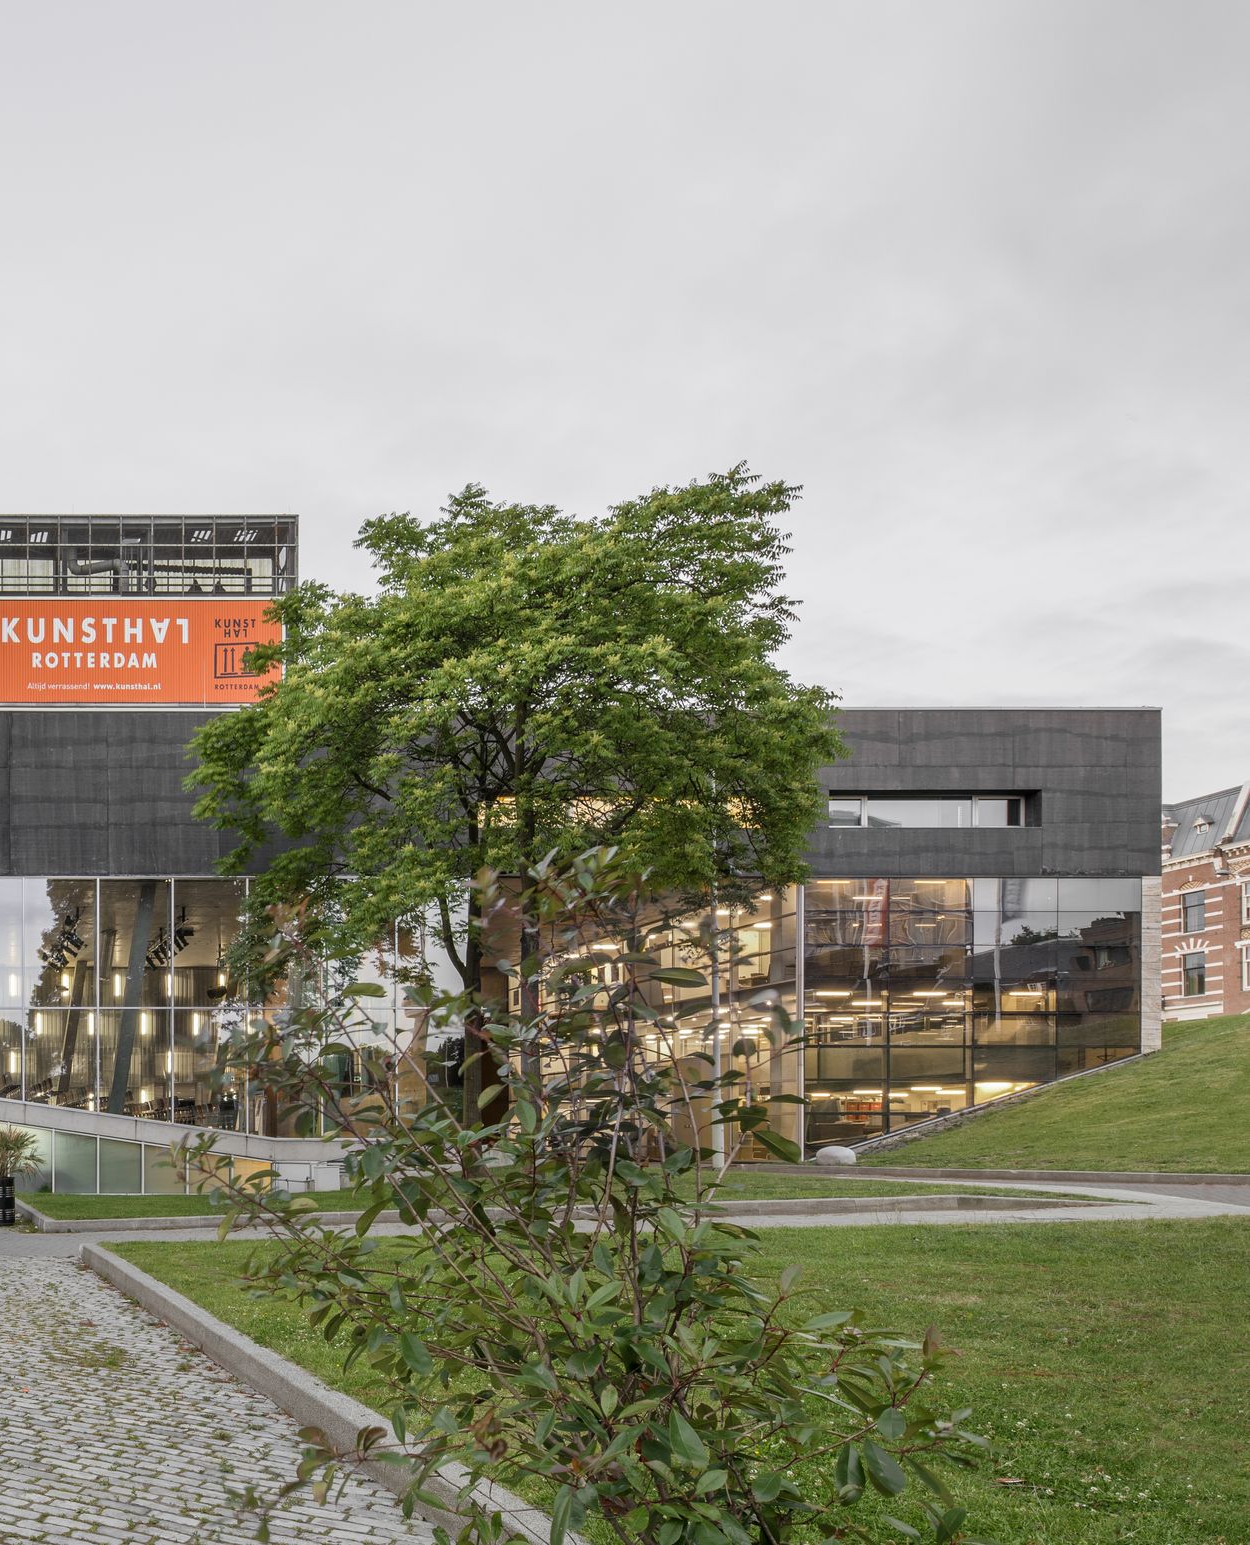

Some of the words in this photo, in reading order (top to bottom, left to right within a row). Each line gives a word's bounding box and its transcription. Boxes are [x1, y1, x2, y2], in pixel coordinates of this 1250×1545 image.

[214, 618, 257, 628] KUNST
[1, 617, 190, 644] KUNSTHAL
[31, 652, 158, 669] ROTTERDAM
[27, 682, 47, 691] Altijd
[47, 682, 91, 690] verrassend!
[93, 682, 162, 690] www.kunsthal.nl
